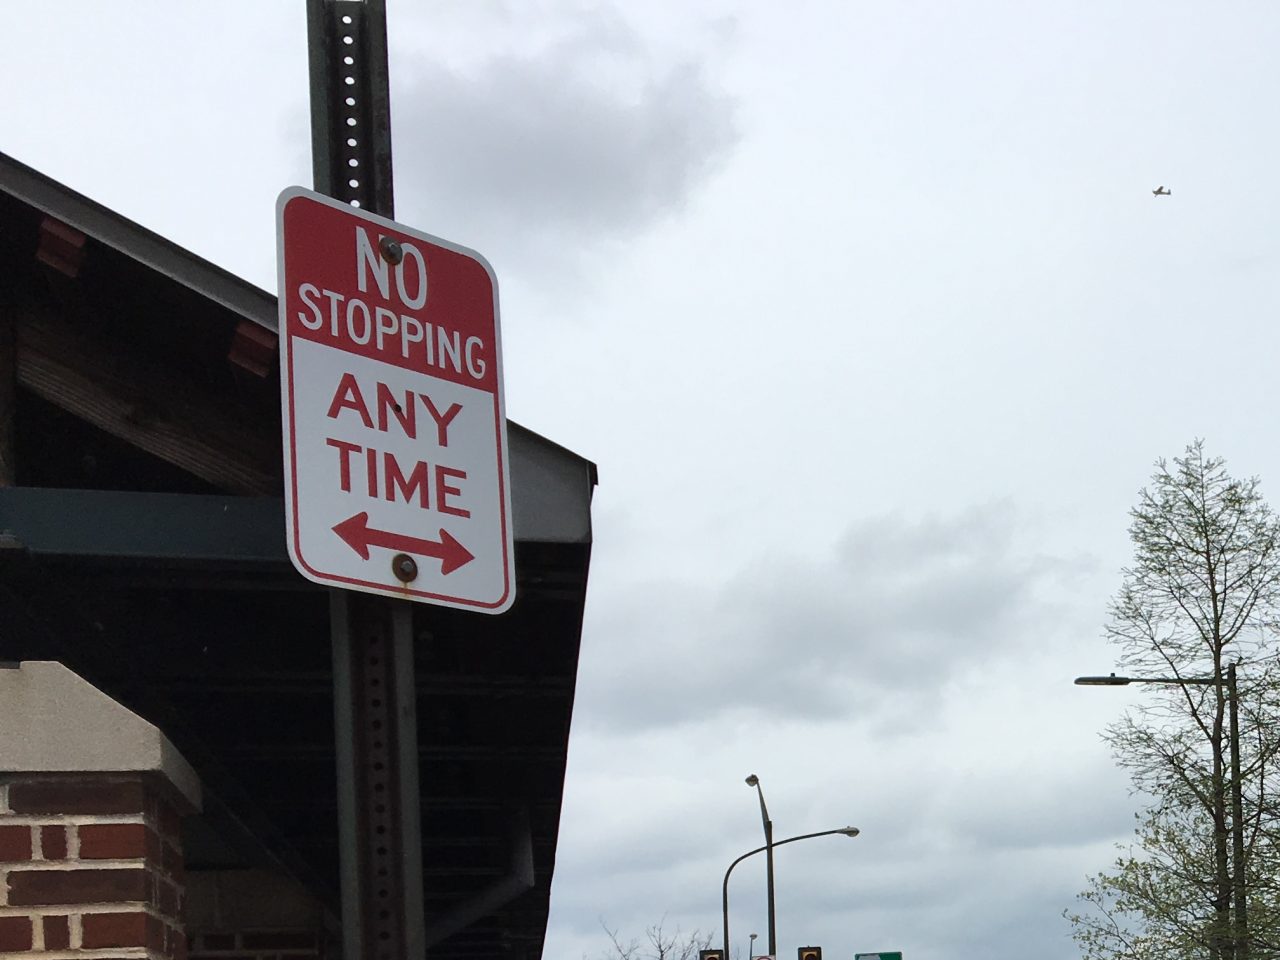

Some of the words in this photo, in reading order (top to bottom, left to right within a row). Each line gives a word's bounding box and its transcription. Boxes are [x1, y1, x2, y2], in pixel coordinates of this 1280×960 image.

[356, 226, 427, 311] NO
[298, 283, 486, 380] STOPPING
[327, 373, 463, 448] ANY
[326, 438, 471, 519] TIME
